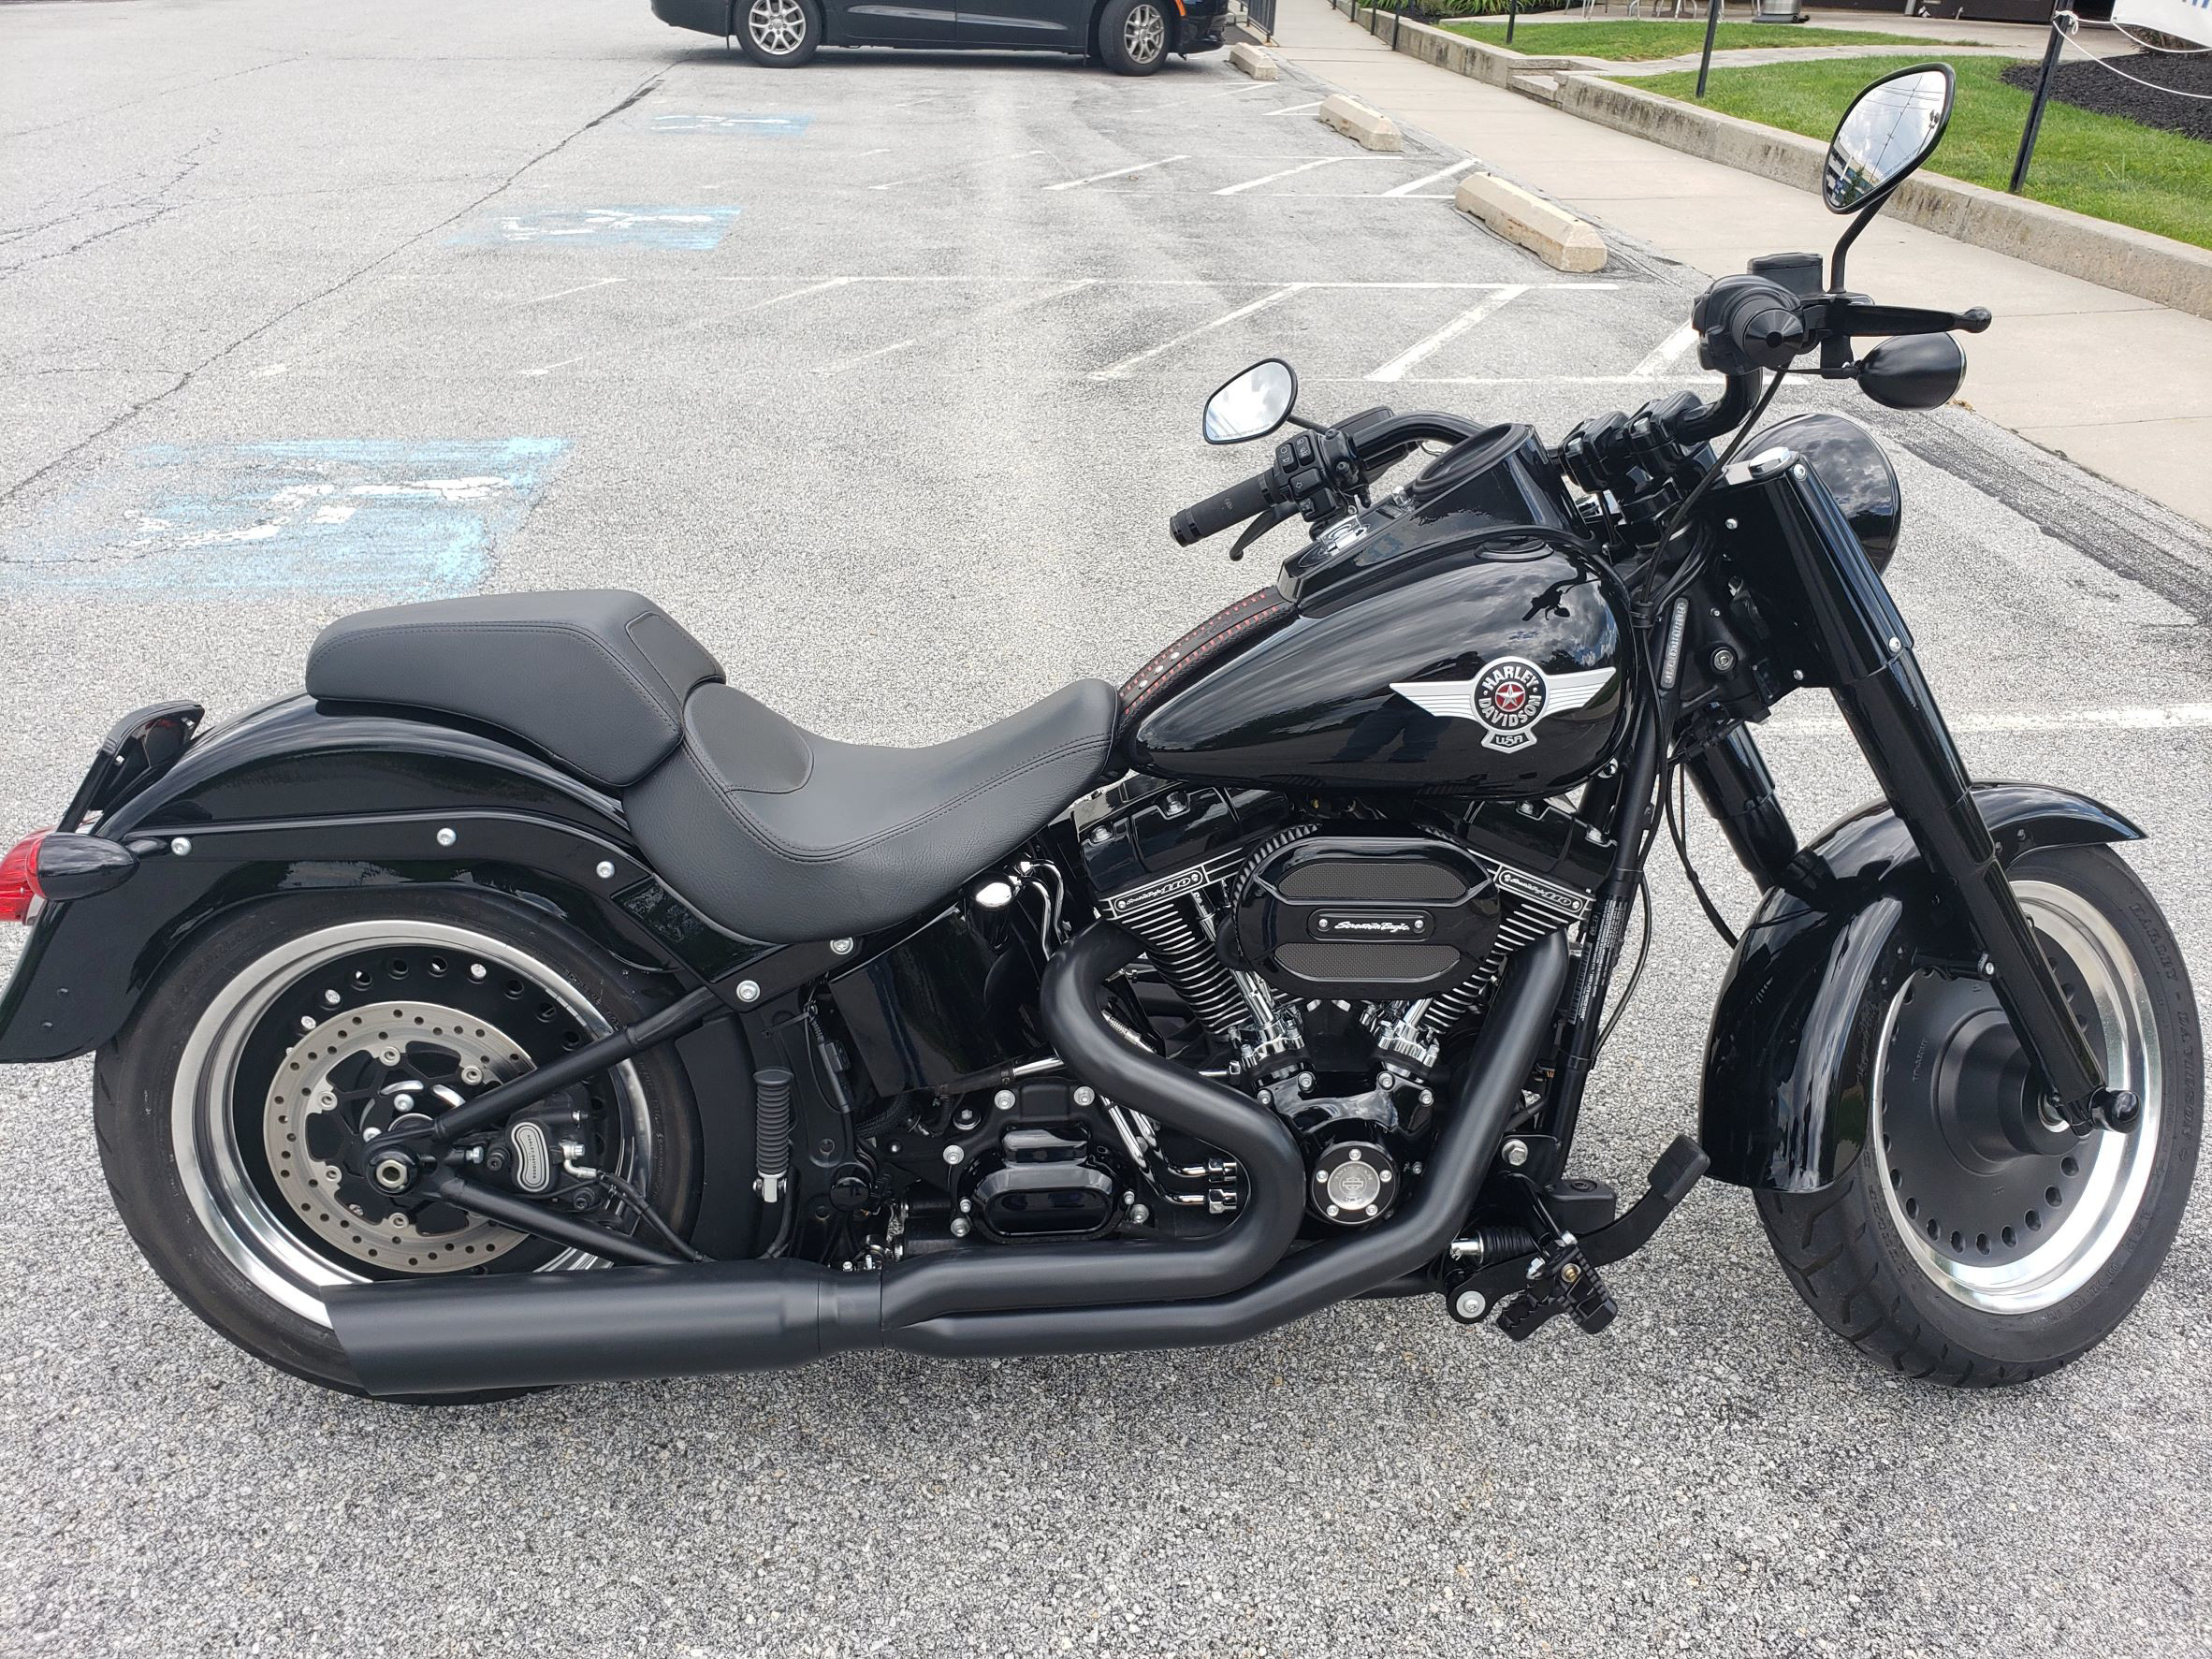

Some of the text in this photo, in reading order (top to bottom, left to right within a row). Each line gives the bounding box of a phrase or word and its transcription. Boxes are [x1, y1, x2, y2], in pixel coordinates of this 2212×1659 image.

[1481, 665, 1540, 691] HARLEY
[1478, 694, 1542, 727] DAVIDSON
[1495, 735, 1523, 747] USA
